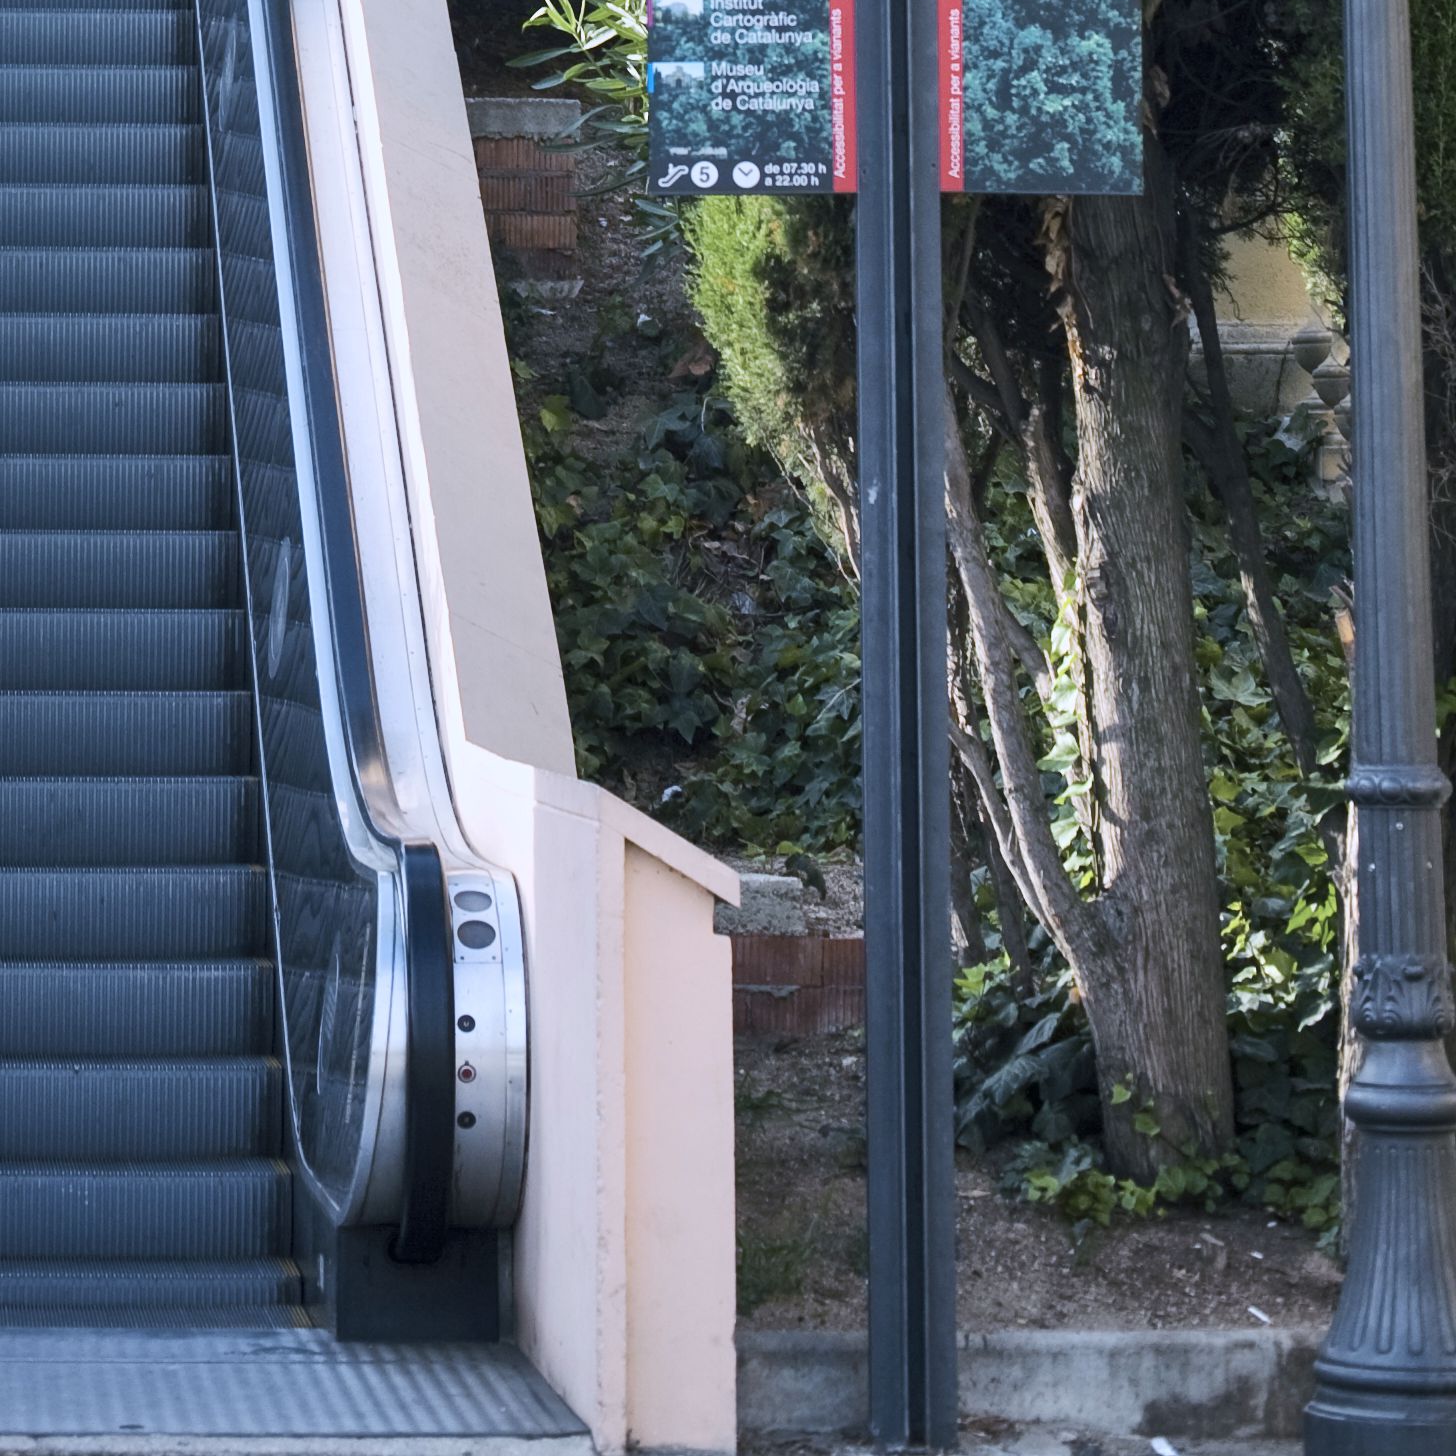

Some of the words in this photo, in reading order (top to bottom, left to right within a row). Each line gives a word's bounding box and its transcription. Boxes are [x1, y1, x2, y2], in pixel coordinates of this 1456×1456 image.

[710, 12, 797, 30] Cartogràfic
[711, 30, 731, 44] de
[735, 30, 813, 46] Catalunya
[831, 8, 842, 60] vianants
[948, 8, 960, 60] vianants
[712, 63, 764, 76] Museu
[834, 63, 842, 71] a
[950, 63, 960, 71] a
[712, 79, 820, 96] d'Arqueologia
[833, 74, 845, 95] per
[949, 74, 962, 95] per
[712, 96, 732, 110] de
[736, 95, 814, 112] Catalunya
[833, 98, 846, 178] Accessibilitat
[948, 98, 960, 178] Accessibilitat
[699, 167, 710, 183] 5
[765, 163, 779, 174] de
[783, 163, 815, 174] 07.30
[818, 163, 826, 174] h
[765, 177, 773, 186] a
[811, 175, 819, 186] h
